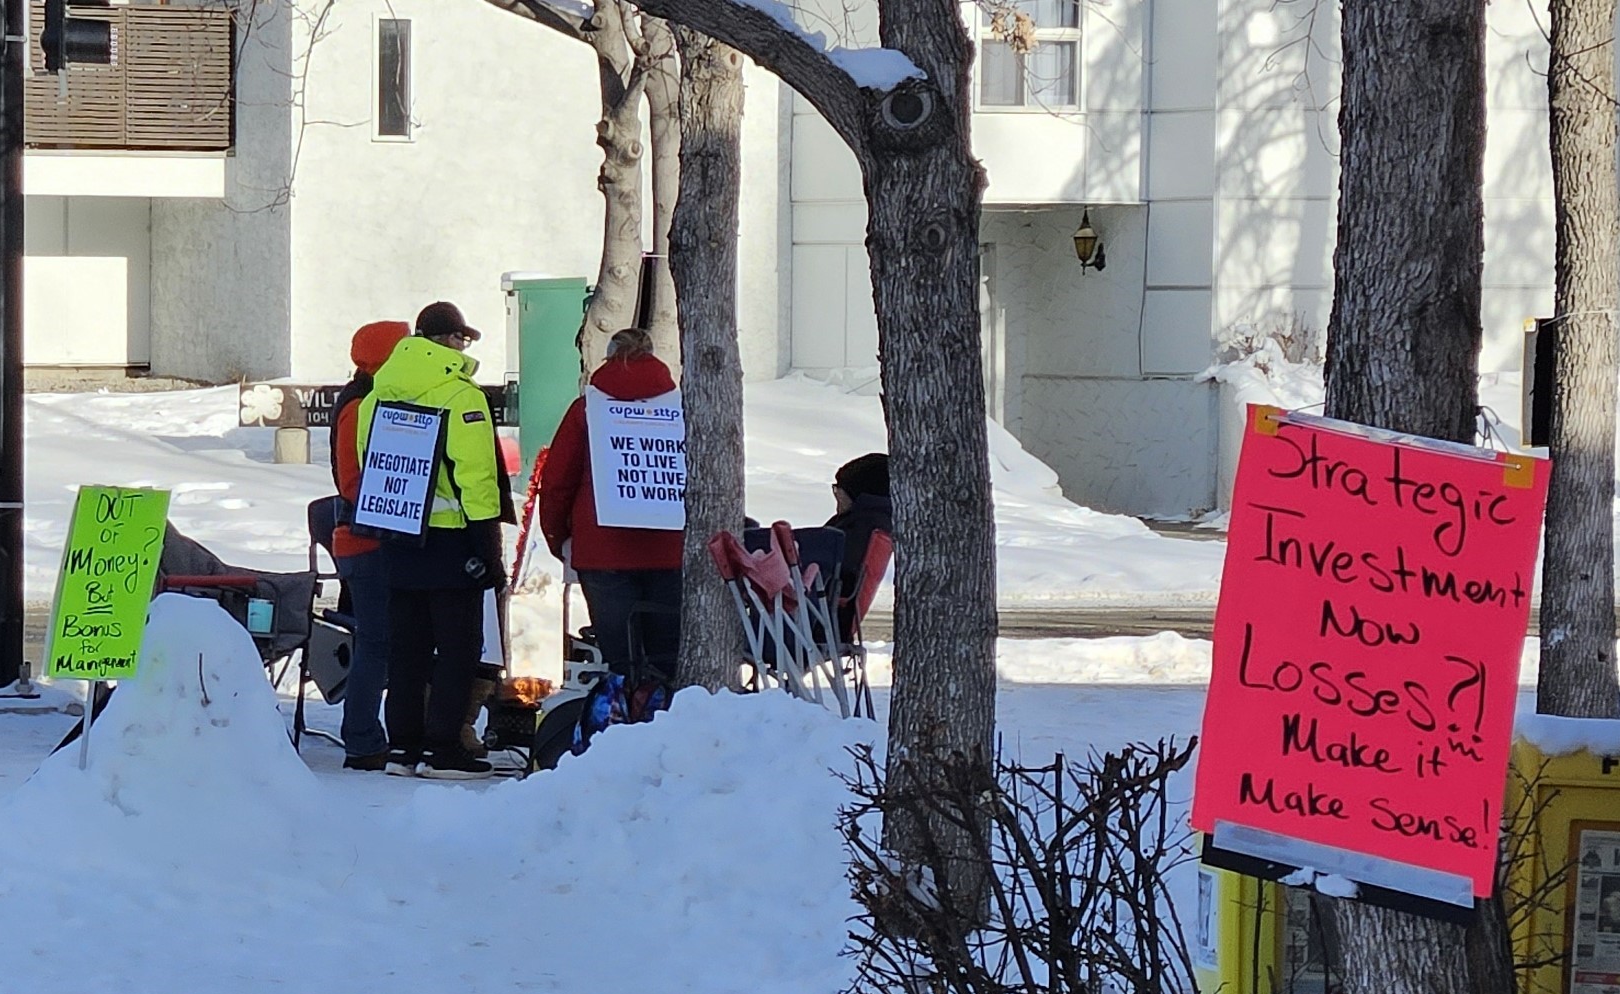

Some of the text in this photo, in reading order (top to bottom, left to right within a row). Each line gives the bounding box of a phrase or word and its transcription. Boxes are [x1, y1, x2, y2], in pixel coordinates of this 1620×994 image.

[308, 411, 329, 423] 104
[610, 436, 687, 454] WE WORK
[369, 451, 430, 477] NEGOTIATE
[621, 453, 678, 469] TO LIVE
[383, 476, 409, 495] NOT
[617, 469, 685, 486] NOT LIVE
[1267, 422, 1516, 556] Strategic
[616, 484, 685, 502] TO WORK
[96, 493, 143, 523] OUT
[361, 494, 422, 520] LEGISLATE
[1247, 502, 1526, 608] Investment
[1282, 713, 1448, 778] Make it
[1239, 772, 1350, 819] Make
